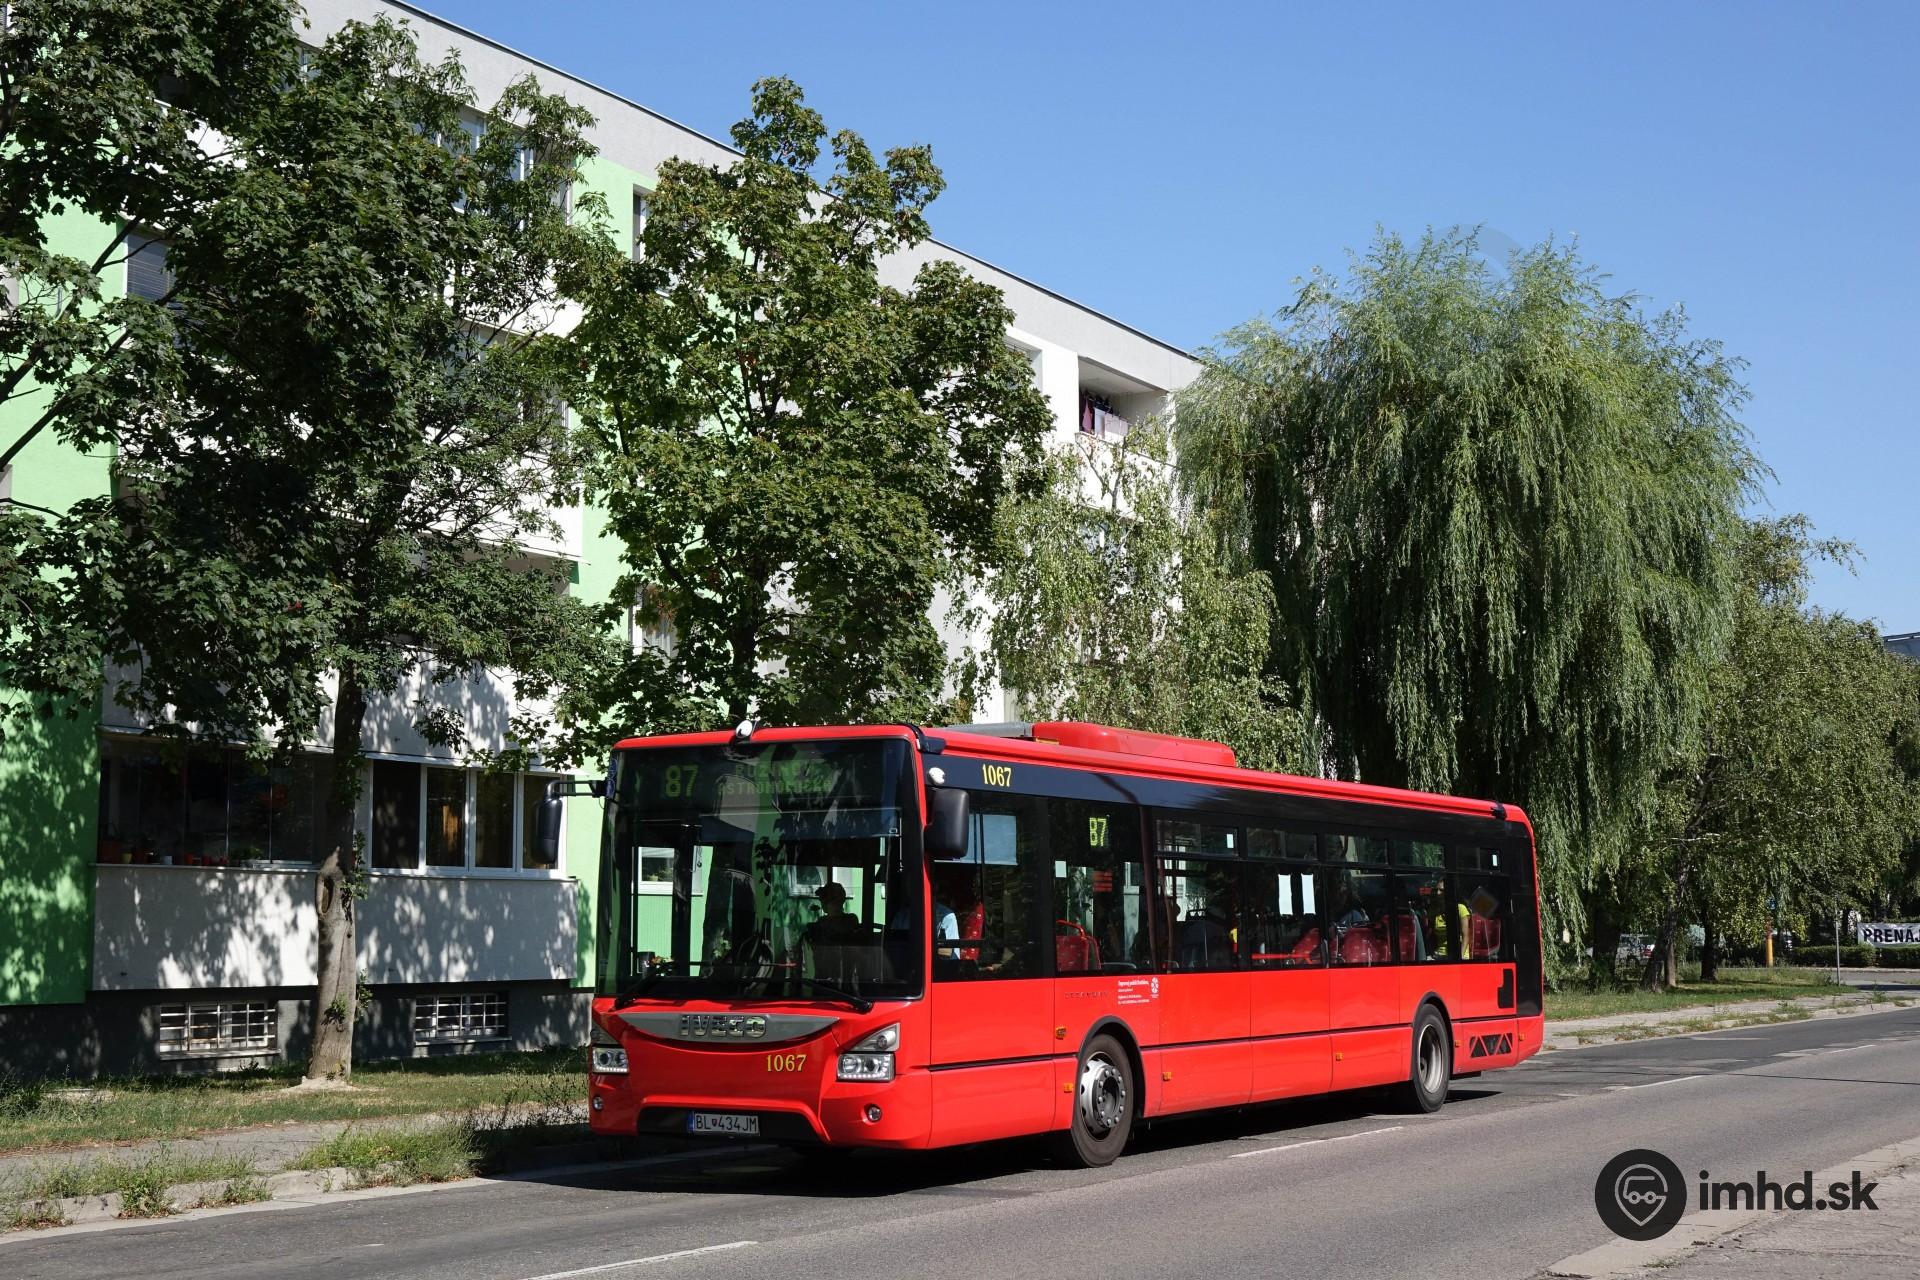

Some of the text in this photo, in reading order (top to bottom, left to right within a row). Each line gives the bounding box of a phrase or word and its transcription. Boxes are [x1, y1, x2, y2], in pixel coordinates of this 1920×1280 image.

[665, 764, 699, 797] 87
[982, 763, 1012, 787] 1067
[680, 1014, 767, 1038] IVECO
[766, 1054, 807, 1072] 1067
